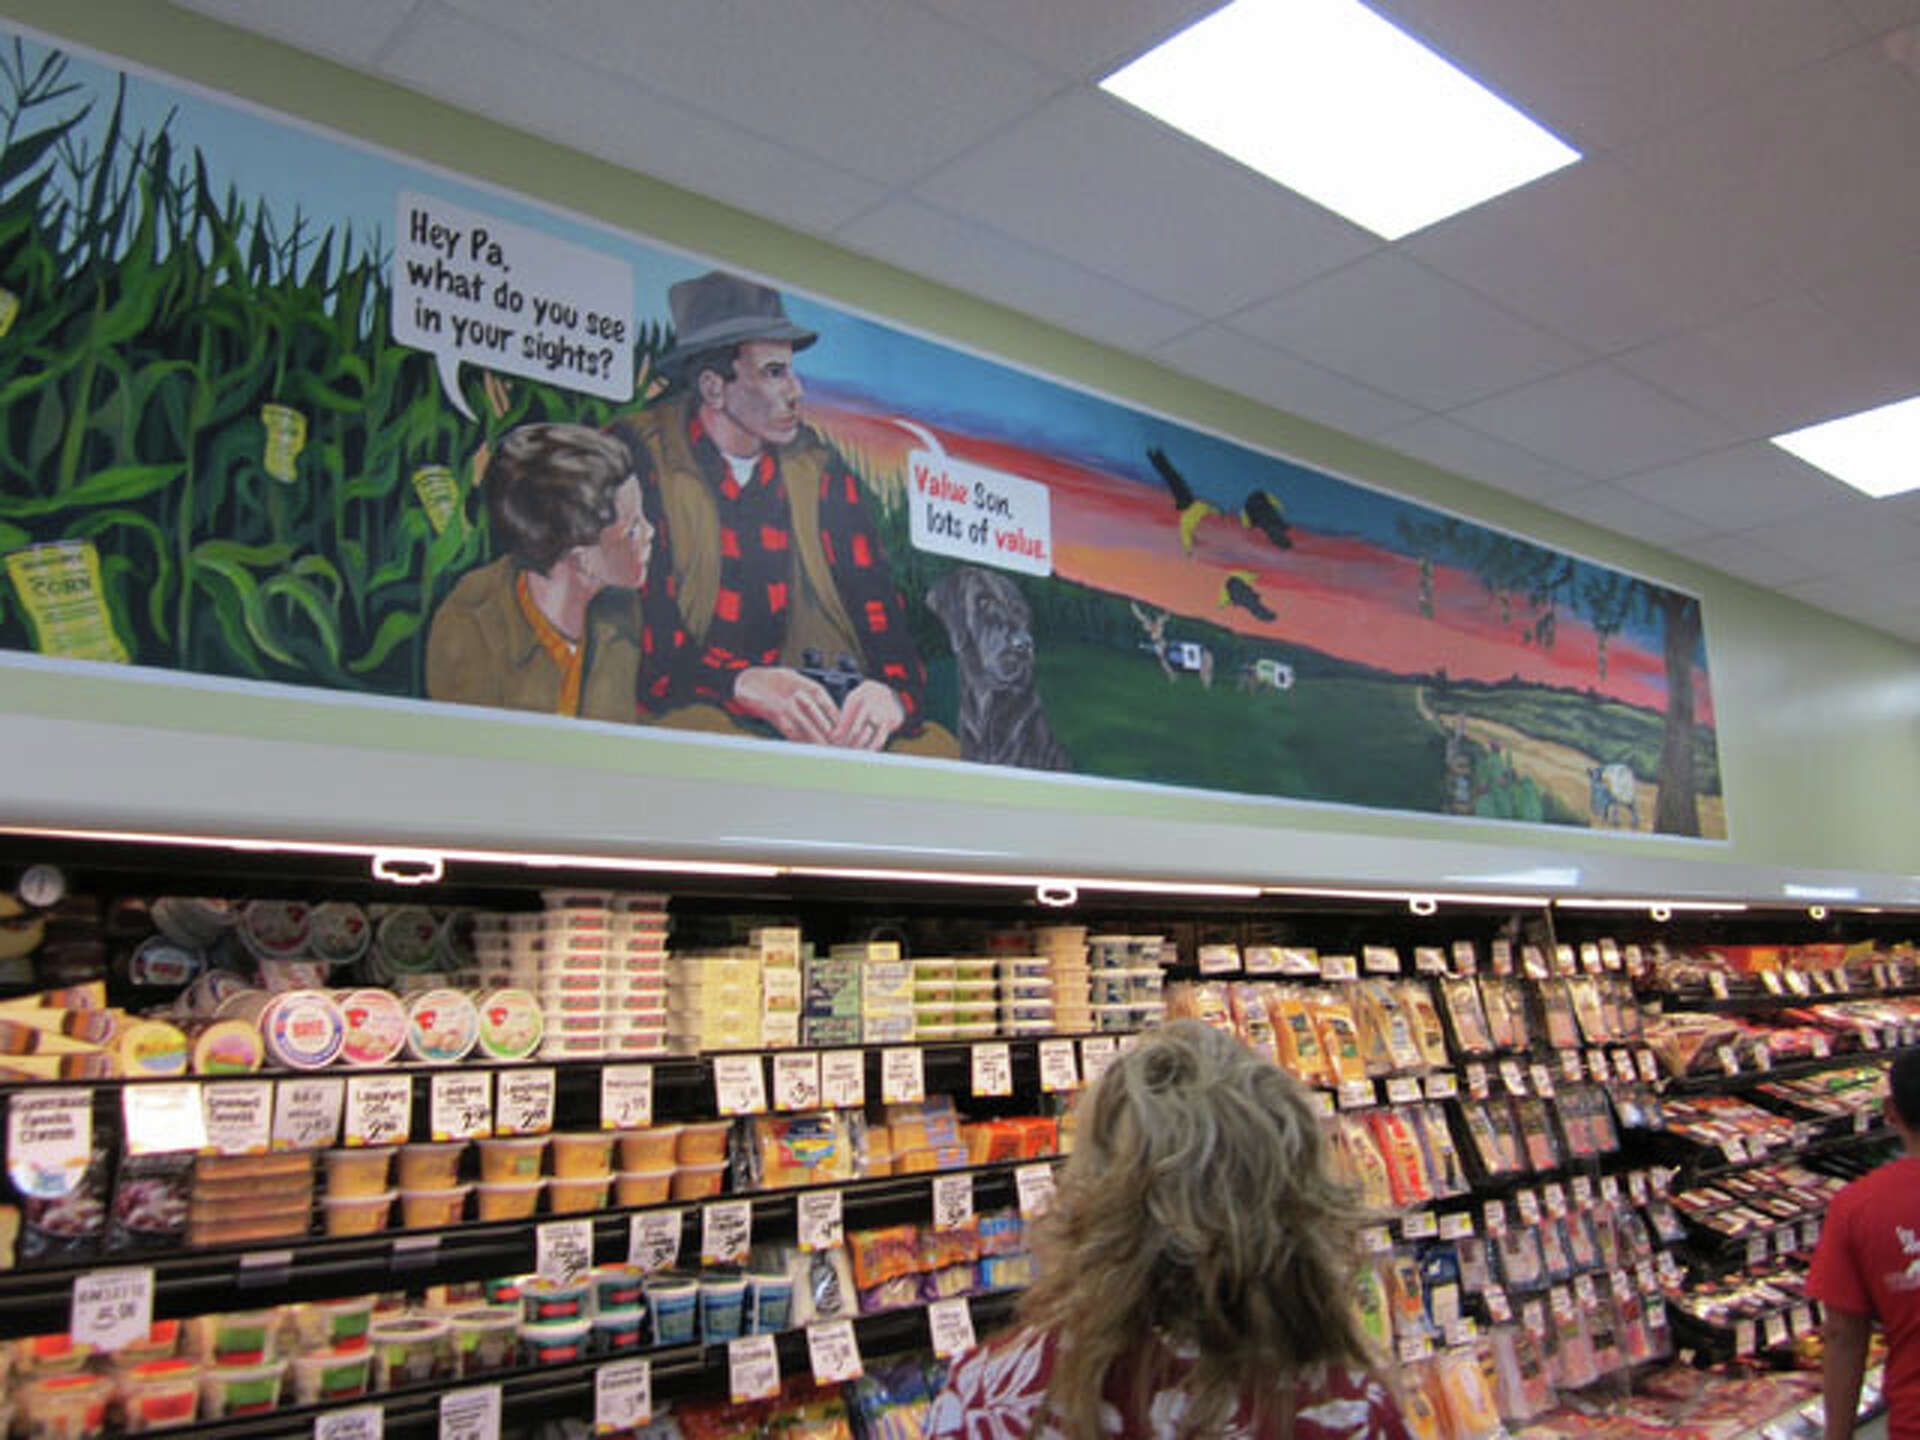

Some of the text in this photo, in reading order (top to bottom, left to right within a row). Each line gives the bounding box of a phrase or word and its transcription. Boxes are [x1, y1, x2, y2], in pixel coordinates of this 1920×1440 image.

[410, 208, 461, 260] Hey
[407, 258, 625, 343] what do you see
[415, 297, 614, 380] in your sights?
[914, 464, 969, 504] Value
[926, 503, 963, 540] lots
[968, 517, 989, 545] of
